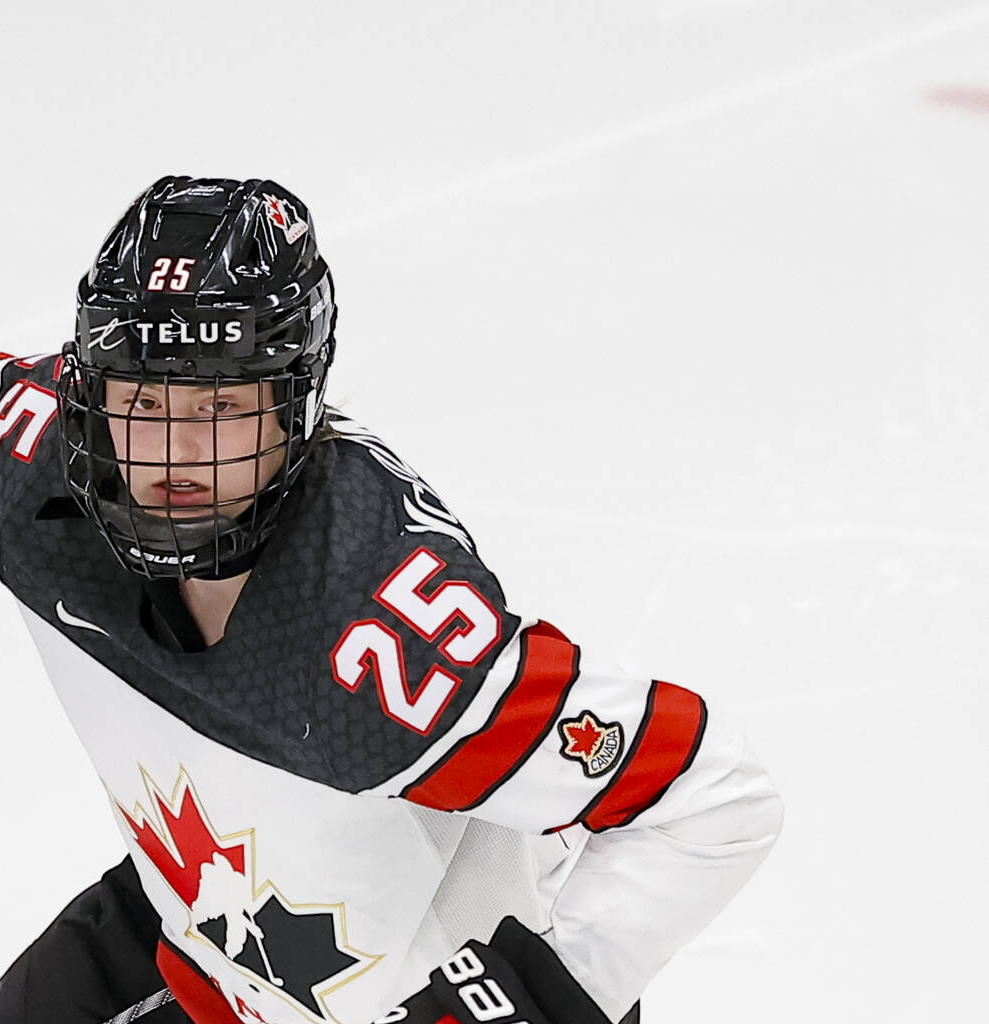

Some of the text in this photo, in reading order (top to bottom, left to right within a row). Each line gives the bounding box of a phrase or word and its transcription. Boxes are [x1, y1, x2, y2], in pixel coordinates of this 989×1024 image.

[147, 257, 196, 291] 25
[137, 321, 243, 344] TELUS
[330, 546, 501, 737] 25
[590, 729, 619, 771] CANADA
